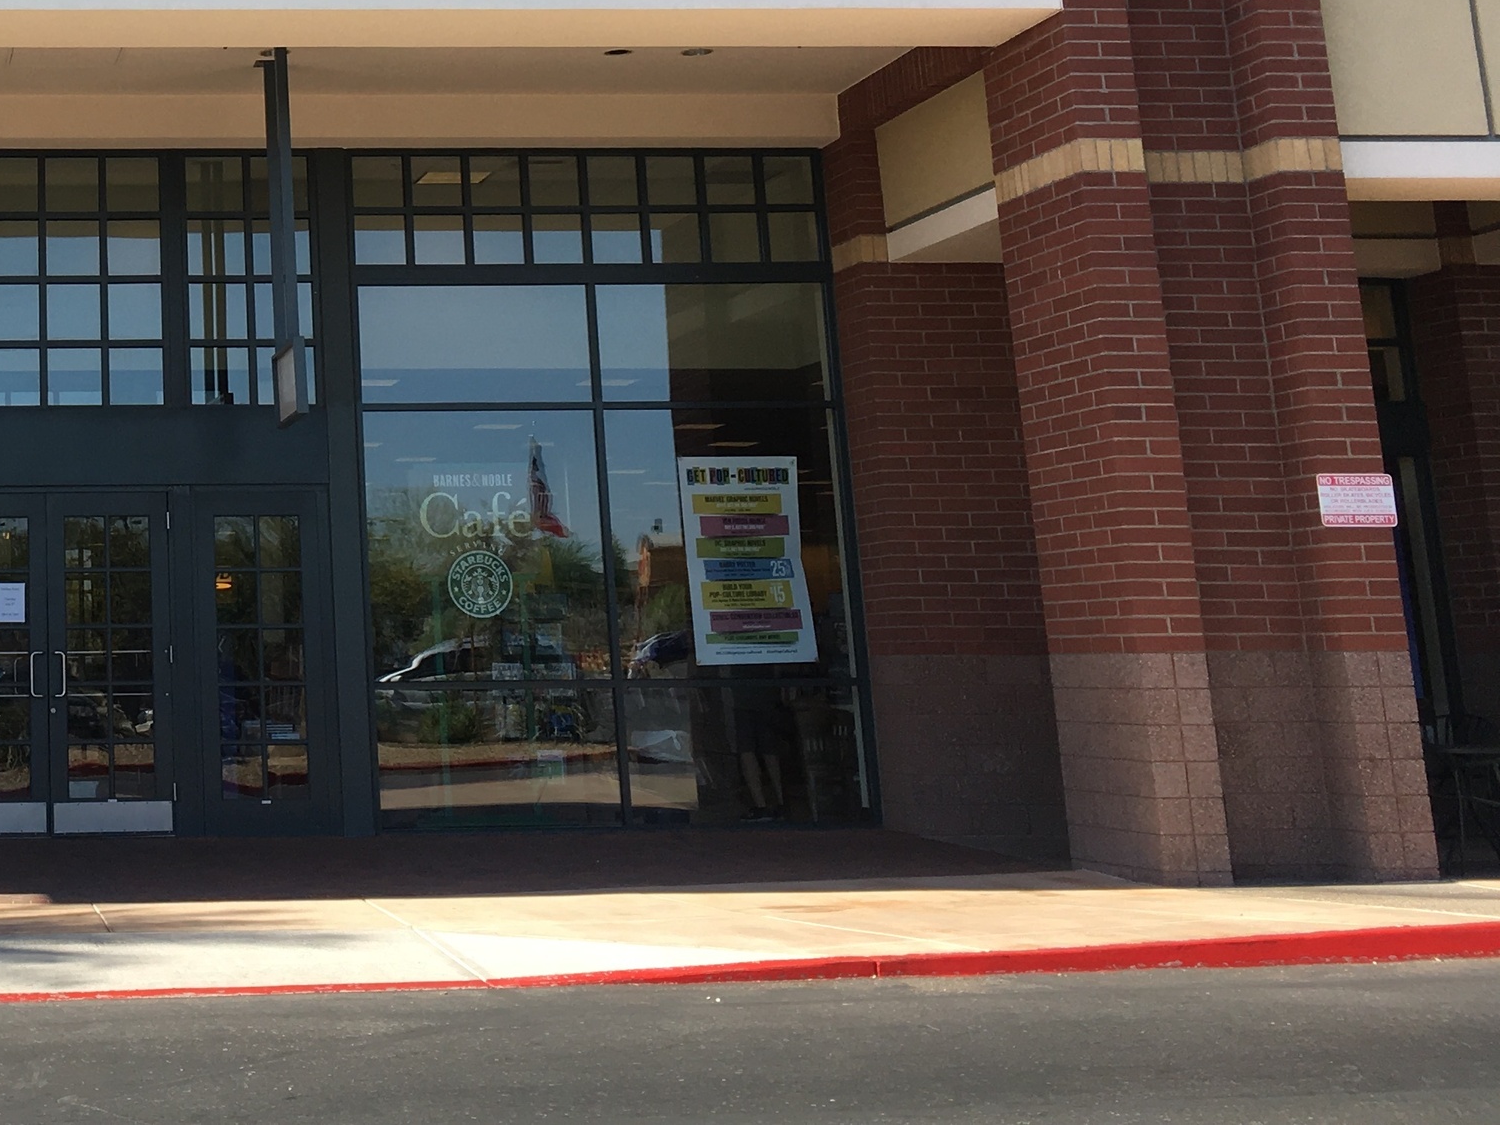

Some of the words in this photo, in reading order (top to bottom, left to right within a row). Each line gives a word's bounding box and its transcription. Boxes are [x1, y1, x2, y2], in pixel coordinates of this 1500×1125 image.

[433, 473, 471, 487] BARNES
[481, 473, 512, 487] NOBLE
[686, 467, 706, 485] GET
[1319, 477, 1332, 485] NO
[1333, 477, 1390, 485] TRESPASSING
[419, 491, 532, 538] Café
[1324, 515, 1355, 524] PRIVATE
[1355, 515, 1394, 523] PROPERTY
[449, 540, 506, 557] SERVING
[452, 554, 509, 583] STARBUCKS
[458, 596, 503, 614] COFFEE
